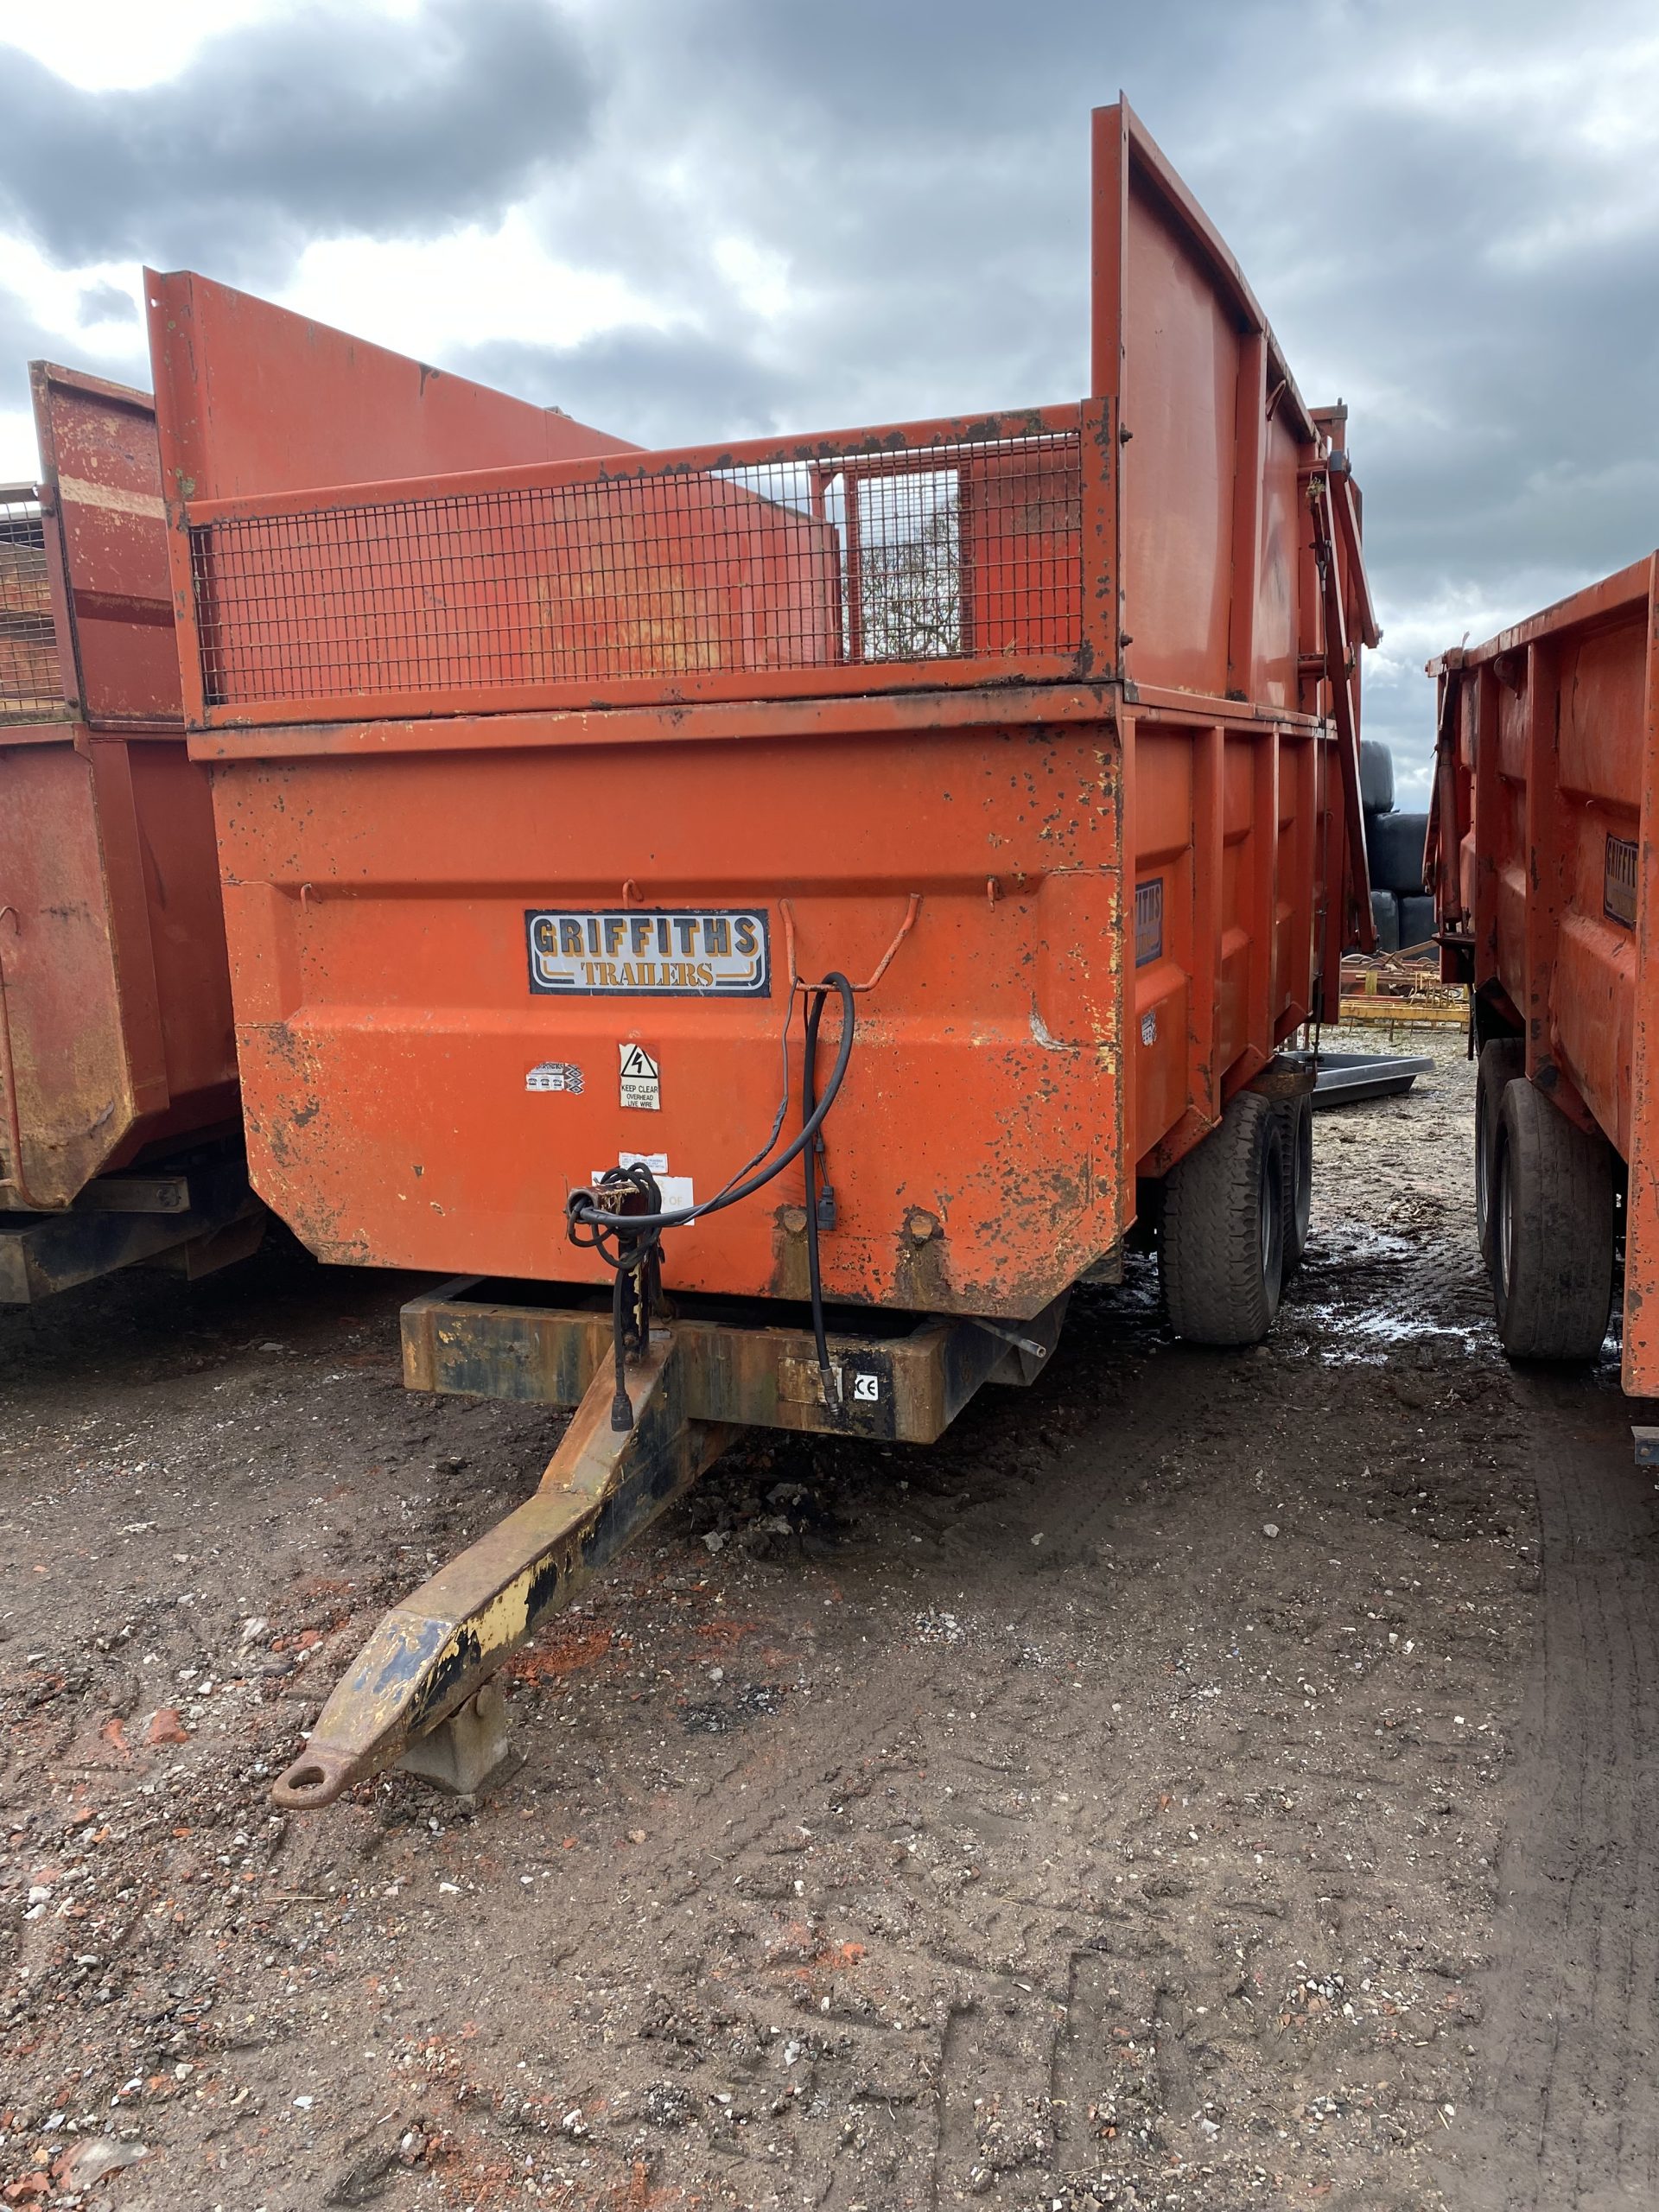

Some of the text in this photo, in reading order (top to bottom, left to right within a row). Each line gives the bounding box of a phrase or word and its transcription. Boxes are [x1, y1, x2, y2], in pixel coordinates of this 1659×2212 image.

[1607, 840, 1637, 888] GRIFFIT
[534, 917, 760, 957] GRIFFITHS
[581, 962, 715, 987] TRAILERS
[856, 1379, 875, 1396] CE
